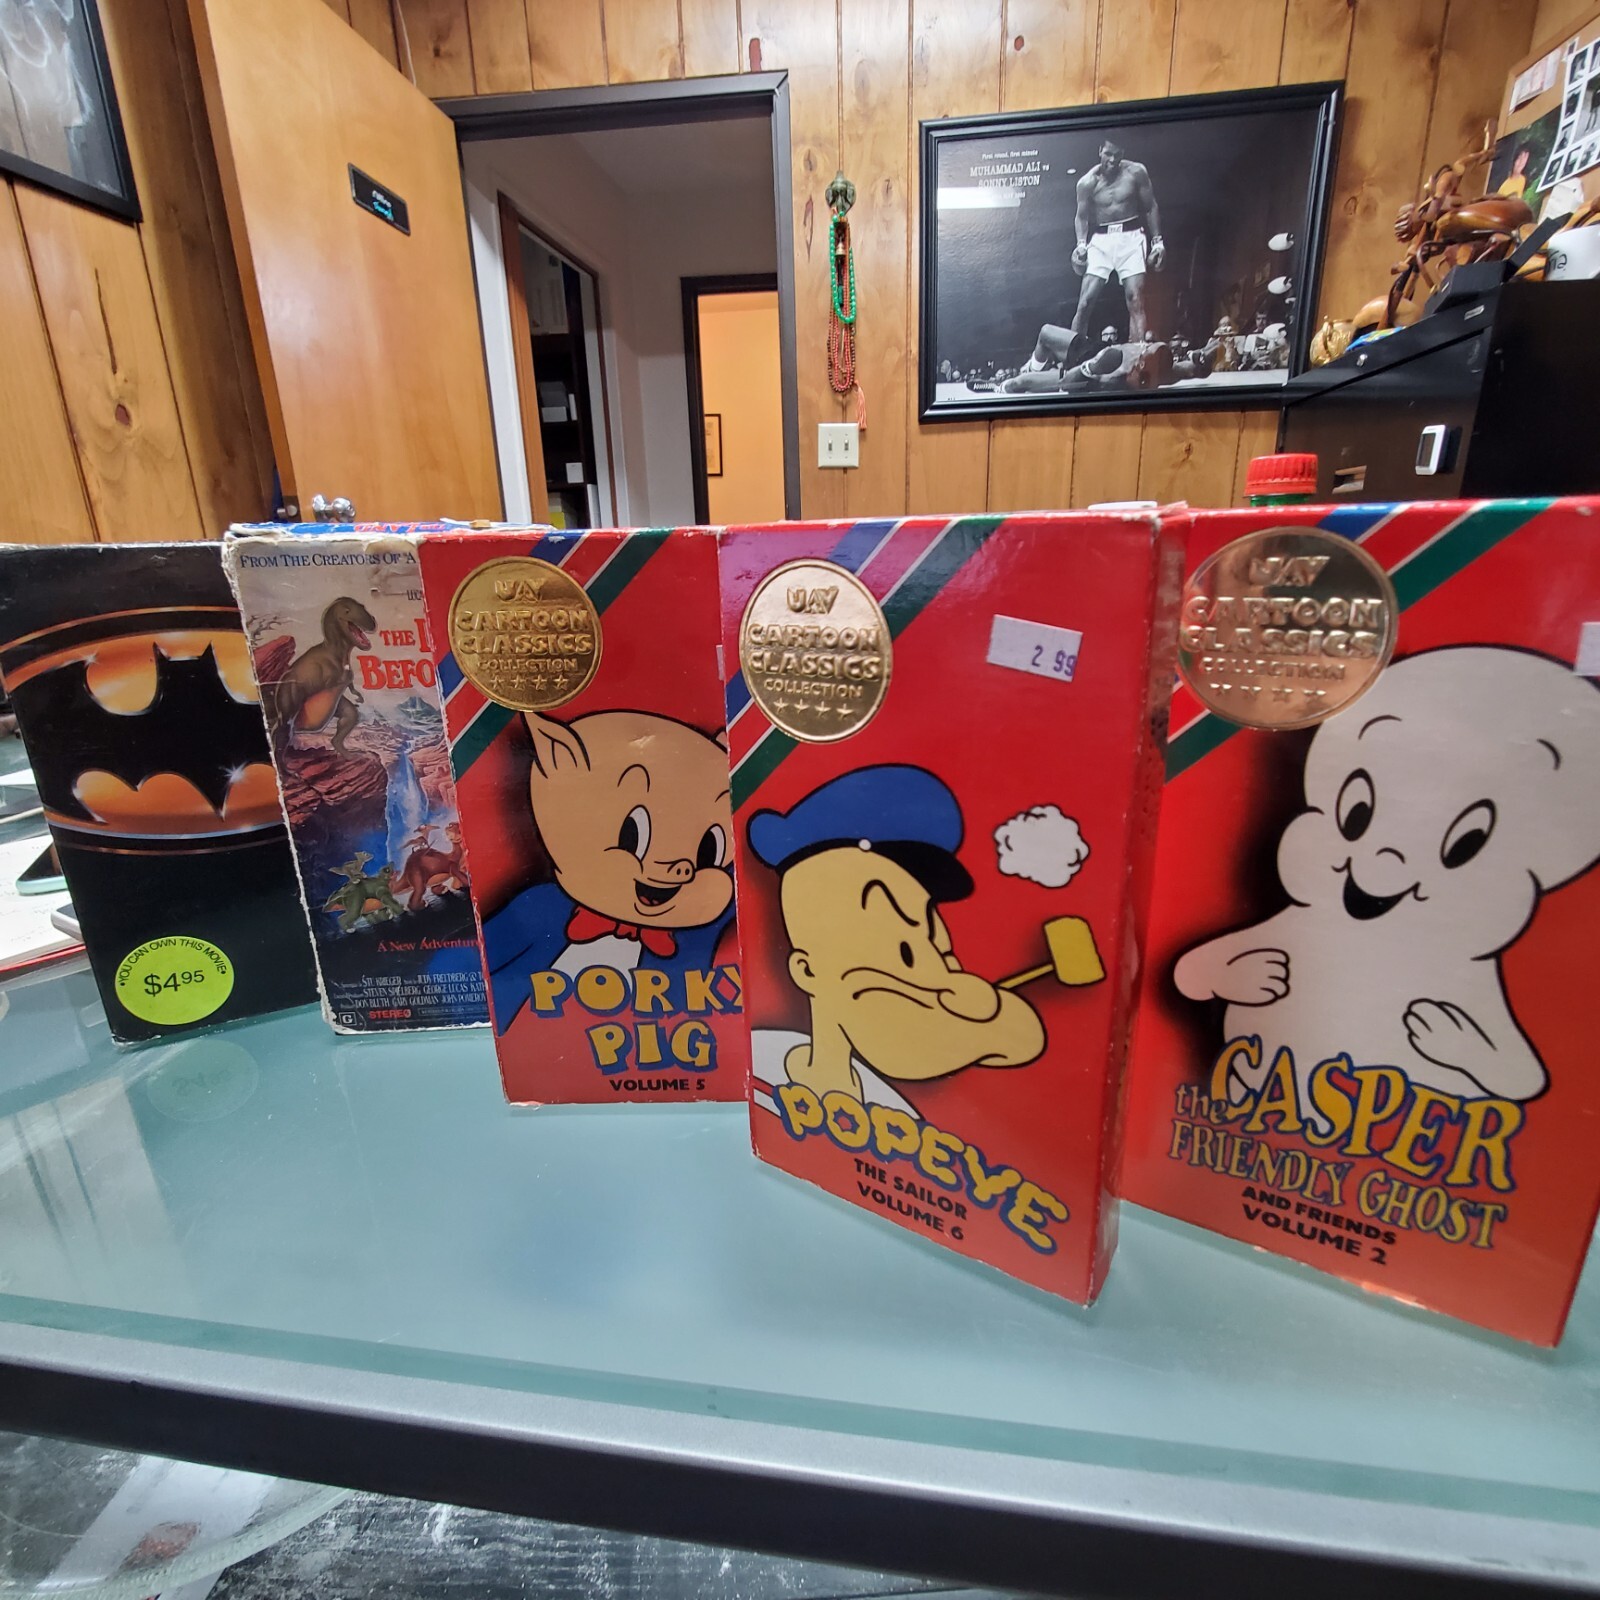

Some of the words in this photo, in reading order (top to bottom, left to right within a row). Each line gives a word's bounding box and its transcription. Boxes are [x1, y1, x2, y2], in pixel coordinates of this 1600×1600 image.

[969, 162, 1024, 177] MUHAMMAD
[1025, 161, 1041, 172] ALI
[979, 176, 1008, 188] SONNY
[1009, 174, 1041, 187] LISTON
[240, 554, 278, 568] FROM
[279, 554, 310, 567] THE
[455, 609, 589, 632] CARTOON
[1183, 596, 1383, 628] CARTOON
[379, 630, 416, 646] THE
[457, 633, 594, 655] CLASSICS
[749, 623, 881, 650] CARTOON
[1180, 625, 1378, 658] CLASSICS
[357, 655, 436, 690] BEFO
[477, 658, 578, 673] COLLECTION
[750, 650, 881, 682] CLASSICS
[763, 678, 864, 698] COLLECTION
[127, 946, 150, 964] CAN
[149, 938, 177, 951] OWN
[179, 938, 204, 951] THIS
[377, 941, 388, 952] A
[390, 940, 416, 952] New
[420, 937, 480, 950] Adventur
[586, 1020, 718, 1074] PIG
[609, 1078, 690, 1091] VOLUME
[696, 1078, 706, 1091] 5
[1175, 1082, 1229, 1125] the
[1209, 1034, 1524, 1191] CASPER
[773, 1082, 1069, 1254] POPEYE
[1168, 1118, 1353, 1206] FRIENDLY
[1357, 1170, 1507, 1249] GHOST
[853, 1157, 888, 1185] THE
[893, 1175, 968, 1220] SAILOR
[856, 1180, 945, 1232] VOLUME
[950, 1224, 965, 1241] 6
[1241, 1184, 1292, 1212] AND
[1294, 1200, 1398, 1246] FRIENDS
[1241, 1201, 1363, 1256] VOLUME
[1369, 1245, 1388, 1265] 2
